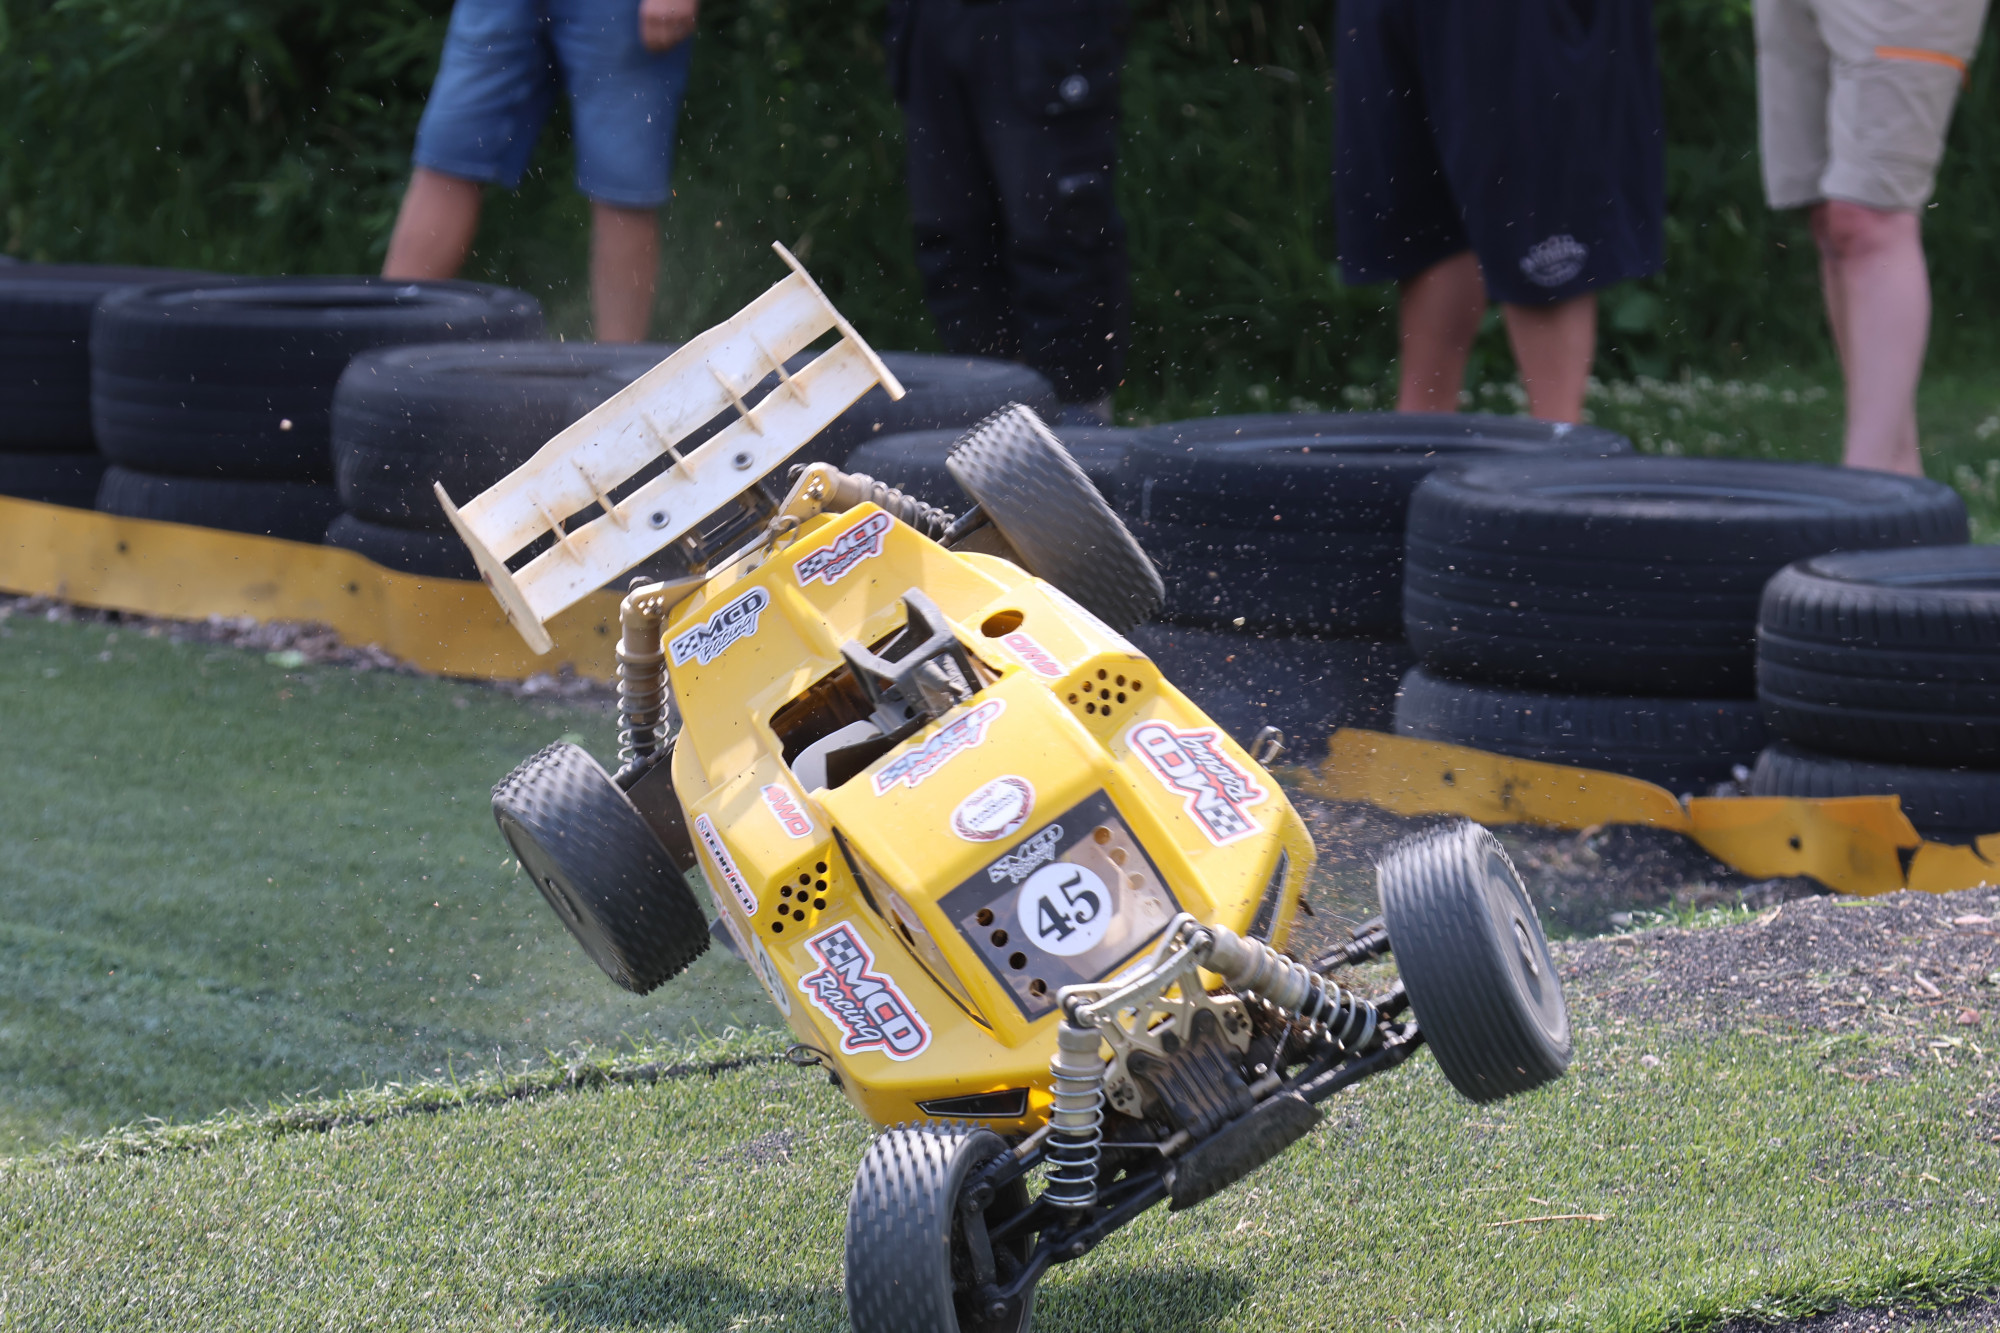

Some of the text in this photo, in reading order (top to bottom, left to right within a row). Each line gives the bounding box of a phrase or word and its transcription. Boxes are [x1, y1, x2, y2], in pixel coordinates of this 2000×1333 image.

[698, 592, 764, 643] MCD
[1004, 634, 1063, 677] 4WD
[1135, 725, 1226, 811] MCD
[1177, 734, 1259, 802] Racing
[764, 785, 811, 836] 4WD
[1037, 869, 1102, 942] 45
[806, 970, 884, 1044] Racing
[838, 957, 922, 1052] MCD
